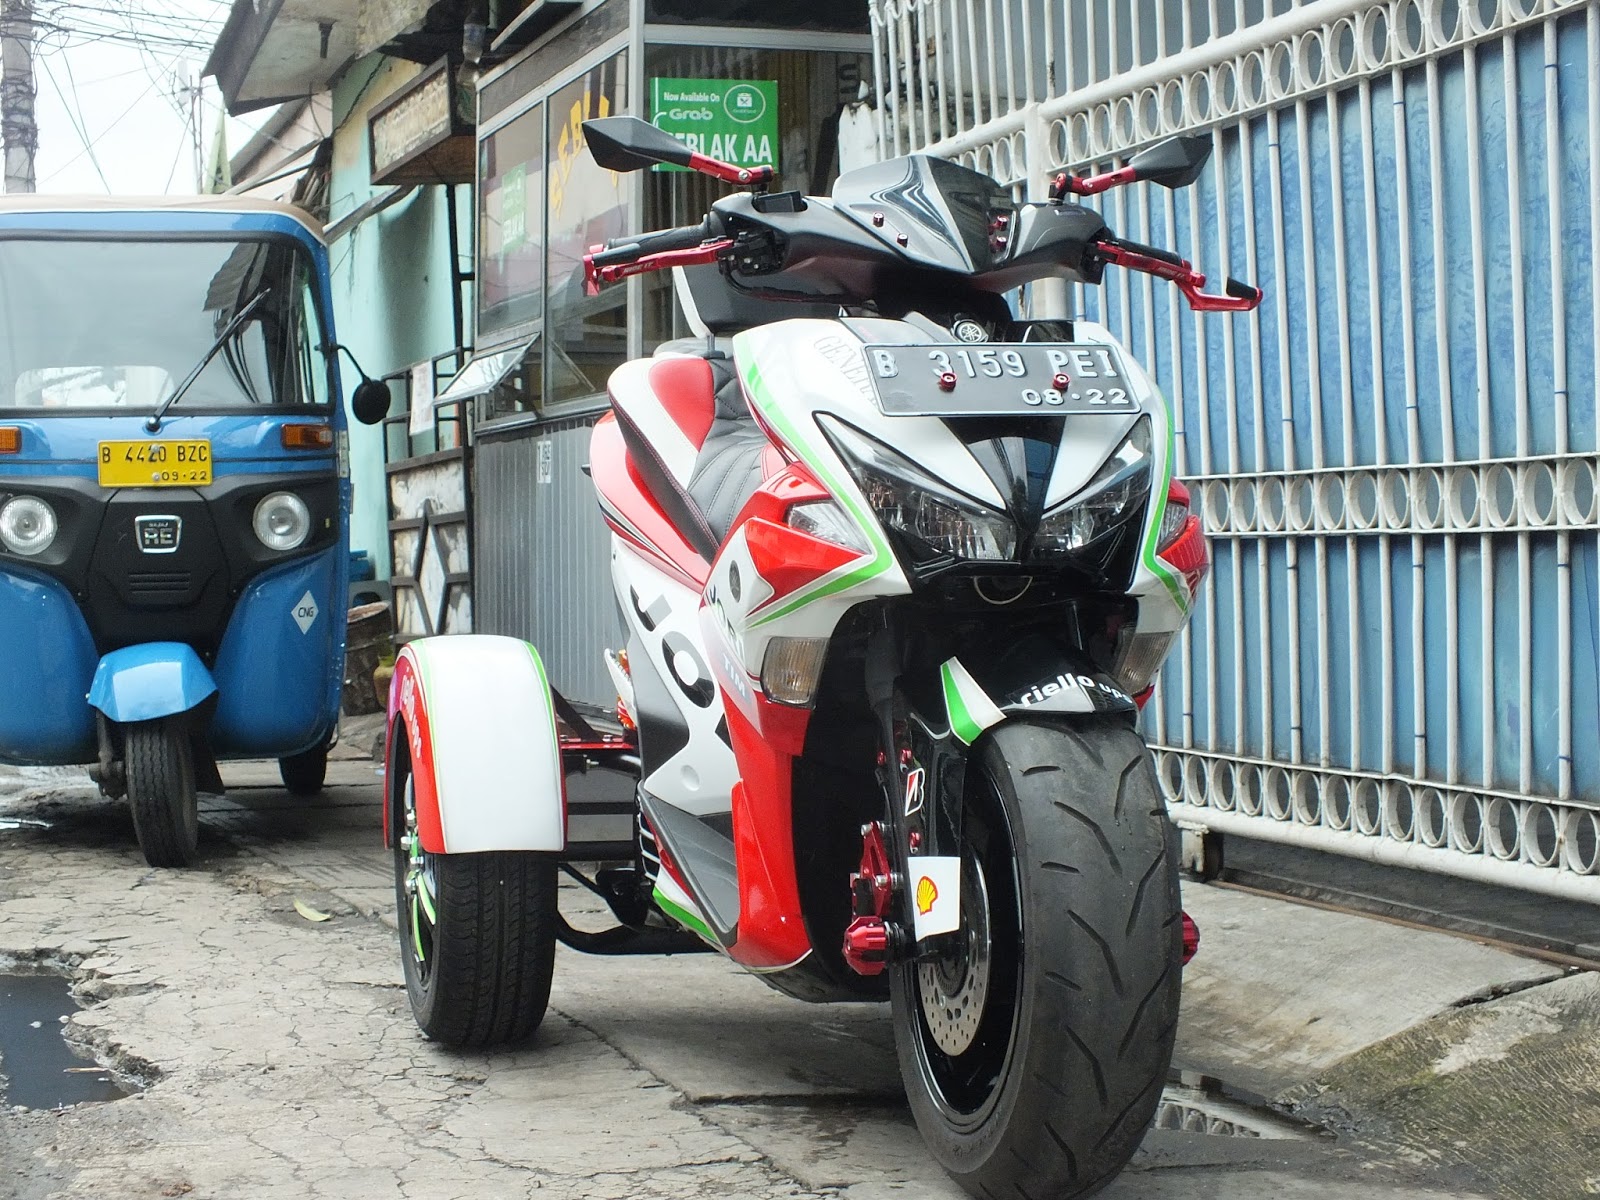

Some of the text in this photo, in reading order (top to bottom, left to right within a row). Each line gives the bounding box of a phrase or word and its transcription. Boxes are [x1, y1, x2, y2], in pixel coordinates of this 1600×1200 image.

[664, 92, 720, 102] Now Available On
[669, 107, 713, 120] Grab
[743, 135, 773, 163] AA
[874, 350, 899, 378] B
[928, 350, 1027, 377] 3159
[102, 446, 207, 463] B 4420 BZC
[144, 528, 173, 545] RE
[297, 606, 314, 618] CNG
[1020, 672, 1096, 708] riello
